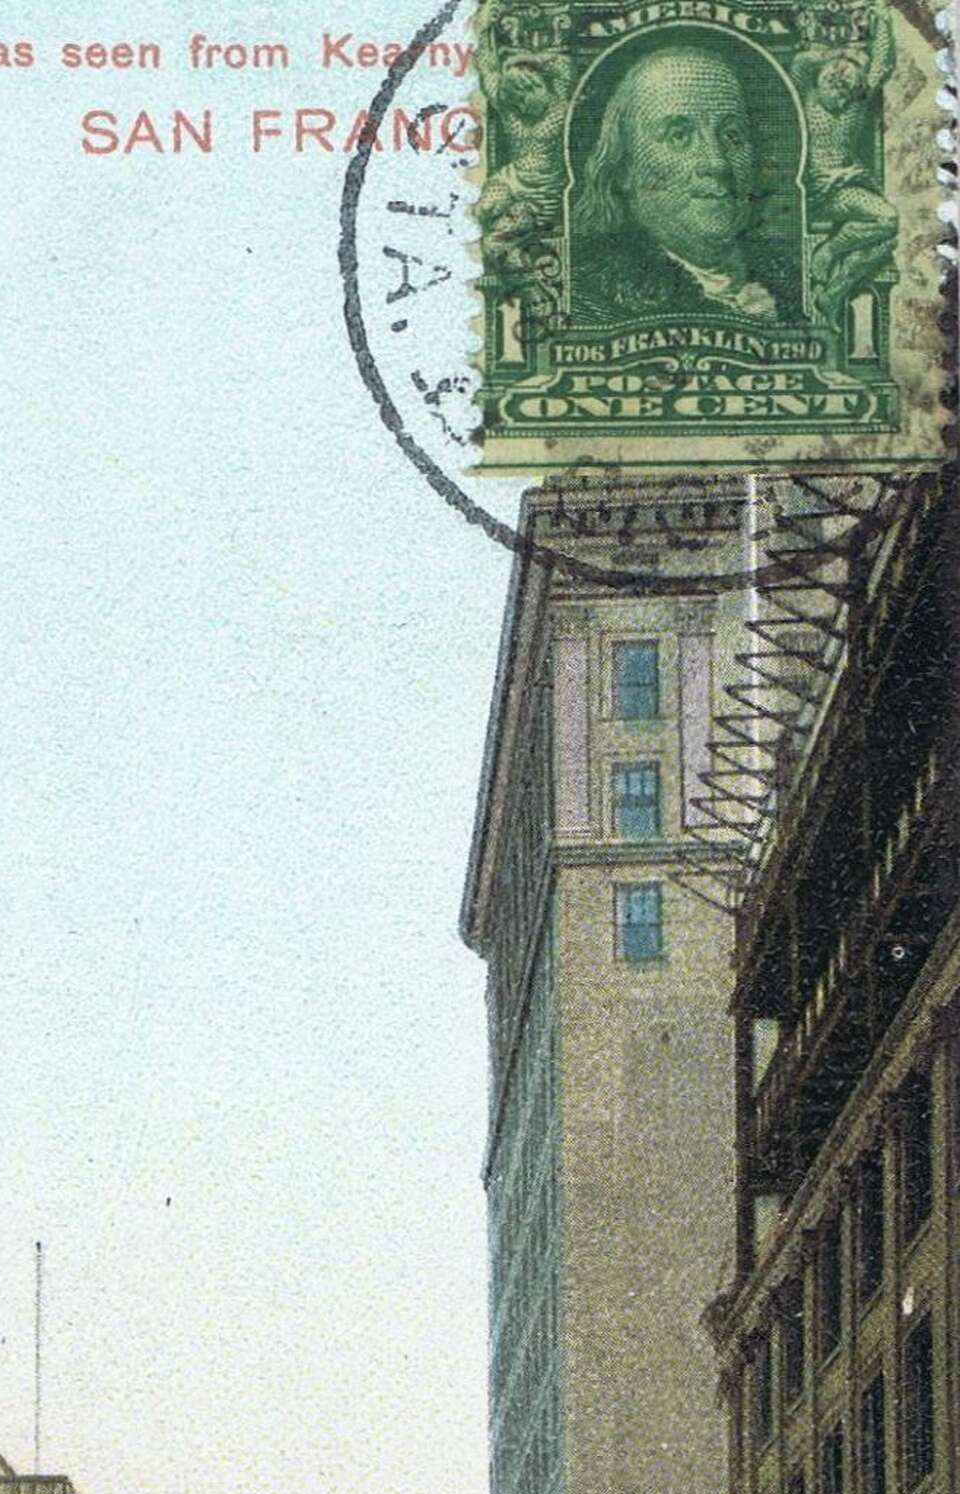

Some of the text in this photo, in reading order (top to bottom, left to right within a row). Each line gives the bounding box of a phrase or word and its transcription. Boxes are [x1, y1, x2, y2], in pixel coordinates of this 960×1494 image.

[577, 0, 791, 37] AMERICA
[500, 297, 525, 363] 1
[553, 344, 606, 363] 1706
[610, 326, 770, 361] FRANKLIN
[850, 292, 880, 360] 1
[568, 373, 805, 393] POSTAGE
[518, 394, 859, 418] ONE CENT
